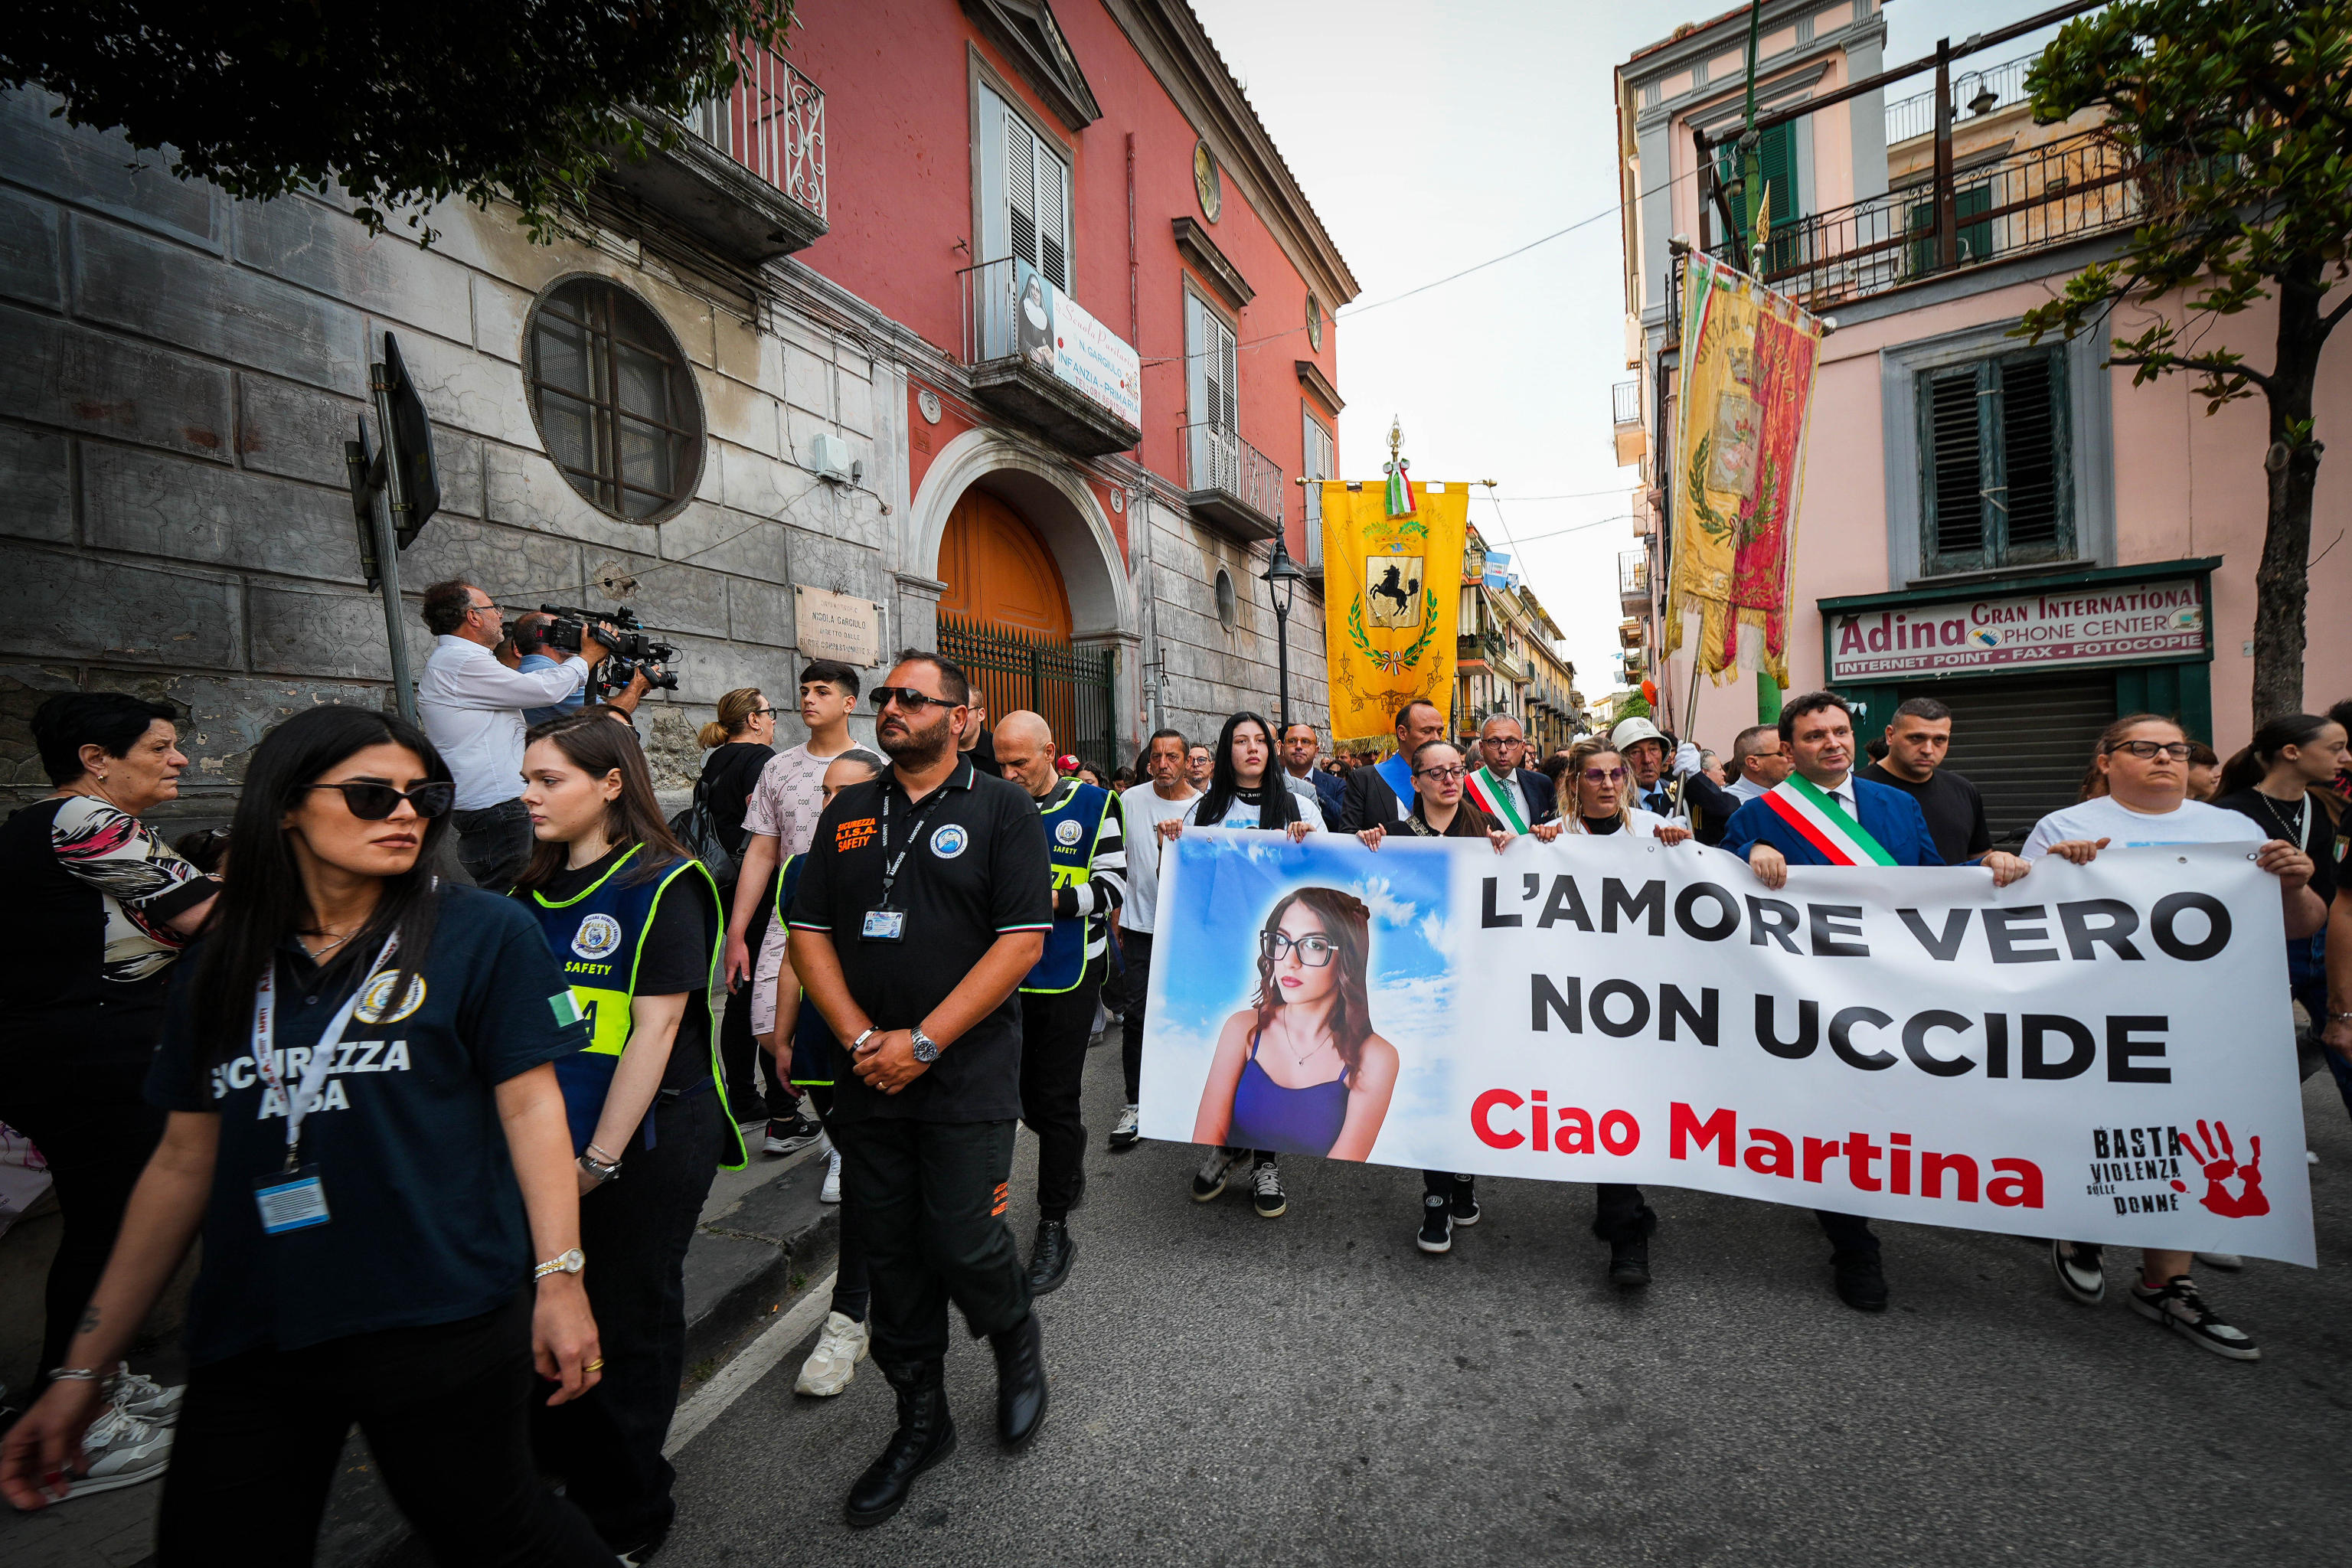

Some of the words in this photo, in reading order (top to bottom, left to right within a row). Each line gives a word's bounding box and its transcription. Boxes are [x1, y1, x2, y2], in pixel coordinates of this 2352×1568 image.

[1063, 304, 1095, 338] Scuola
[1088, 346, 1122, 378] GARGIULO
[1058, 350, 1099, 387] INFANZIA
[1105, 382, 1139, 415] PRIMARIA
[812, 612, 835, 624] NICOLA
[1838, 612, 1965, 656] Adina
[1971, 602, 2028, 626] GRAN
[2004, 623, 2075, 644] PHONE
[2082, 615, 2168, 637] CENTER
[820, 629, 842, 638] DIRETTO
[844, 632, 860, 641] DALLE
[1839, 657, 1927, 674] INTERNET
[1934, 652, 1994, 666] POINT
[2012, 647, 2053, 661] FAX
[2073, 635, 2203, 655] FOTOCOPIE
[835, 826, 877, 841] A.I.S.A.
[838, 818, 876, 832] SICUREZZA
[838, 835, 871, 853] SAFETY
[1053, 845, 1077, 855] SAFETY
[889, 851, 906, 876] SECURITY
[1481, 873, 1870, 957] L'AMORE
[1896, 892, 2232, 963] VERO
[564, 961, 612, 975] SAFETY
[1531, 973, 1719, 1047] NON
[1755, 993, 2172, 1084] UCCIDE
[1470, 1088, 1640, 1156] Ciao
[1669, 1101, 2044, 1210] Martina
[2093, 1126, 2183, 1159] BASTA
[2089, 1158, 2181, 1183] VIOLENZA
[2086, 1184, 2115, 1195] SULLE
[2113, 1194, 2179, 1216] DONNE
